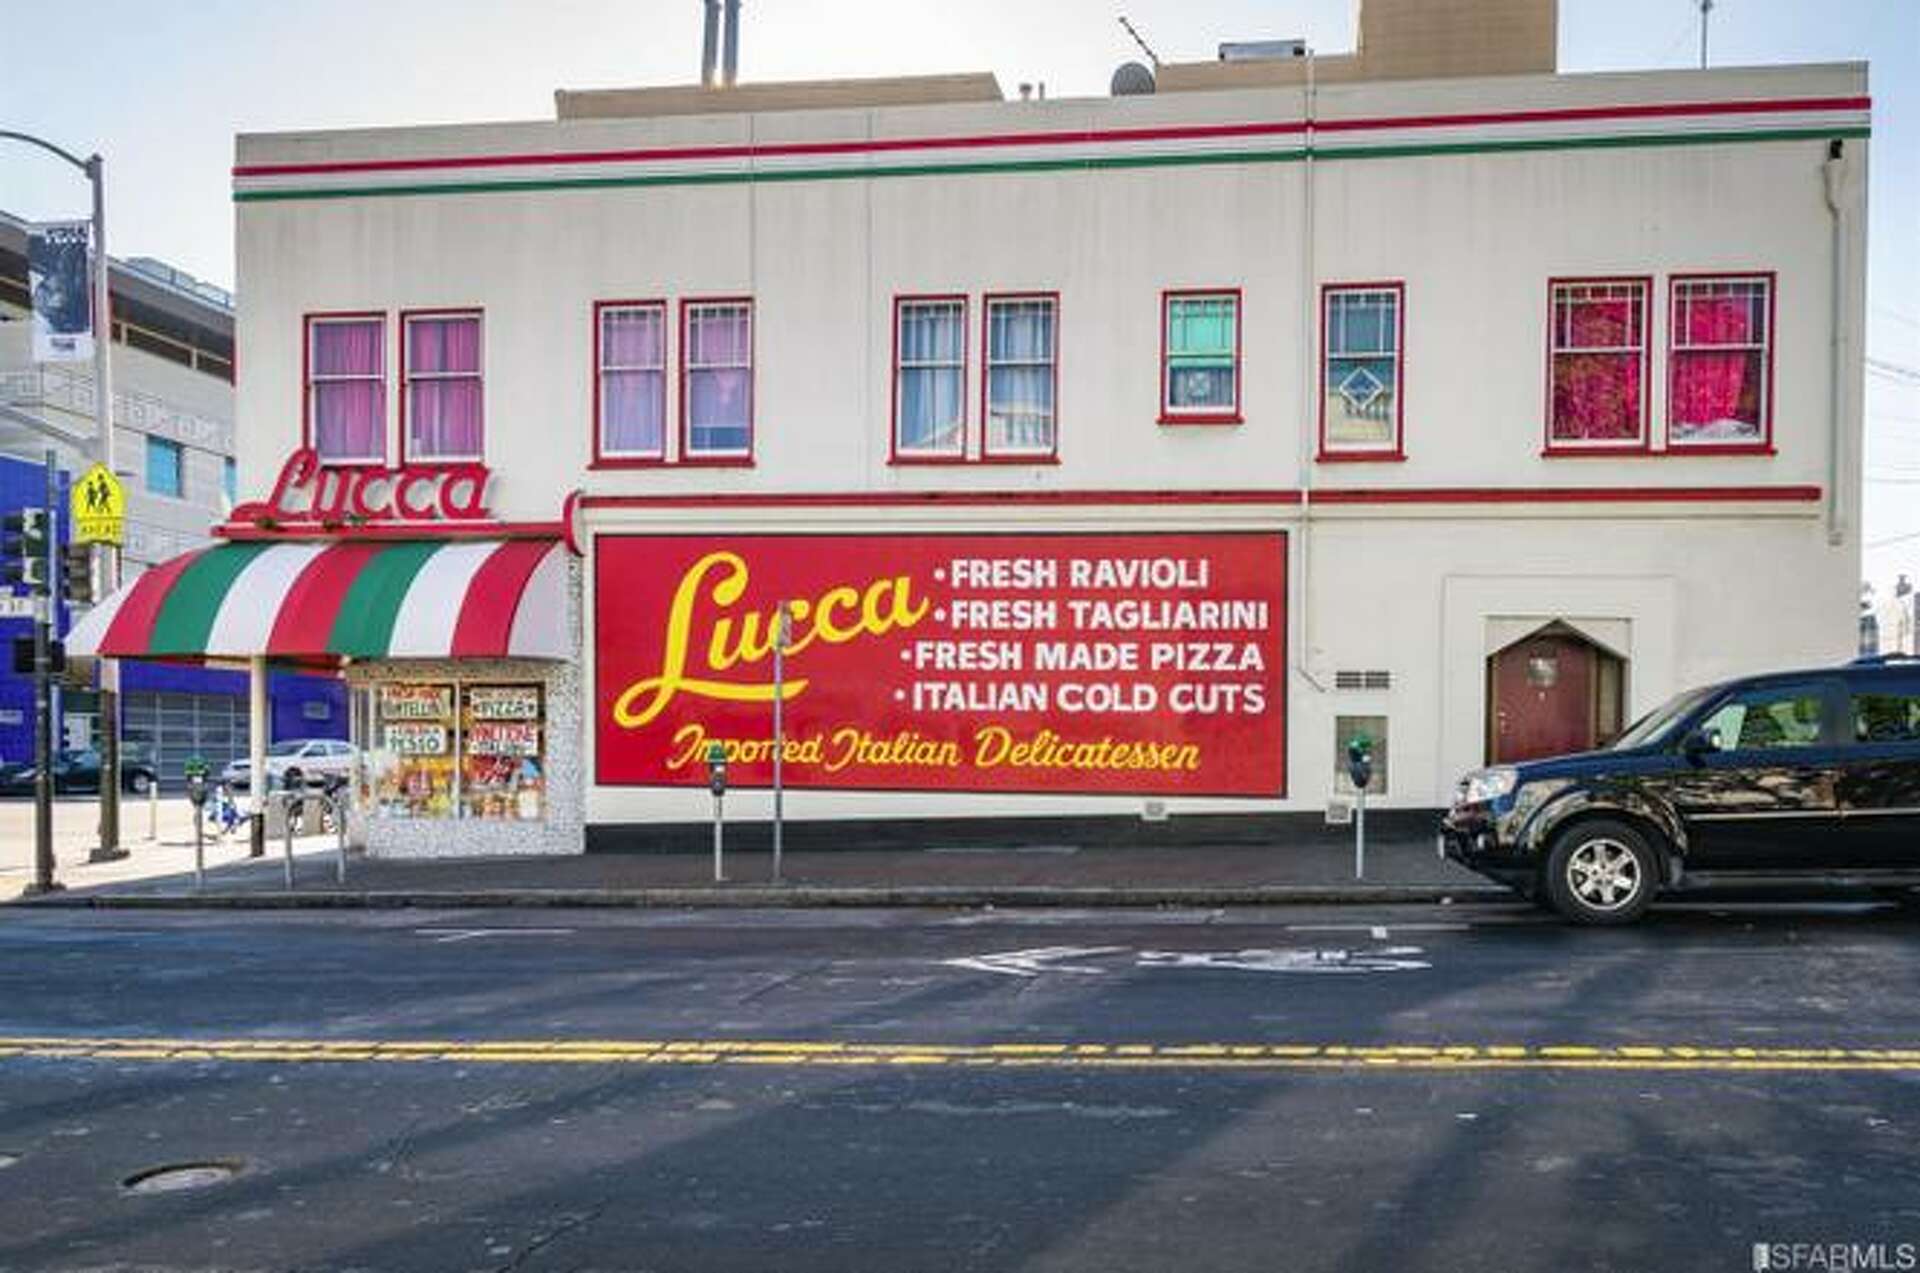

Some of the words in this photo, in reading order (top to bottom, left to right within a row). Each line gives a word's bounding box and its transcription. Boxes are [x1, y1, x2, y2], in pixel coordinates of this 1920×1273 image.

[229, 447, 491, 522] Lucca
[950, 558, 1057, 589] FRESH
[1069, 558, 1208, 589] RAVIOLI
[951, 600, 1057, 630] FRESH
[1068, 600, 1269, 631] TAGLIARINI
[613, 551, 930, 728] Lucca
[914, 640, 1023, 671] FRESH
[1034, 642, 1138, 671] MADE
[1151, 643, 1264, 672] PIZZA
[913, 682, 1048, 712] ITALIAN
[1056, 683, 1158, 713] COLD
[1169, 683, 1265, 714] CUTS
[825, 728, 962, 772] Italian
[975, 726, 1200, 770] Delicatessen
